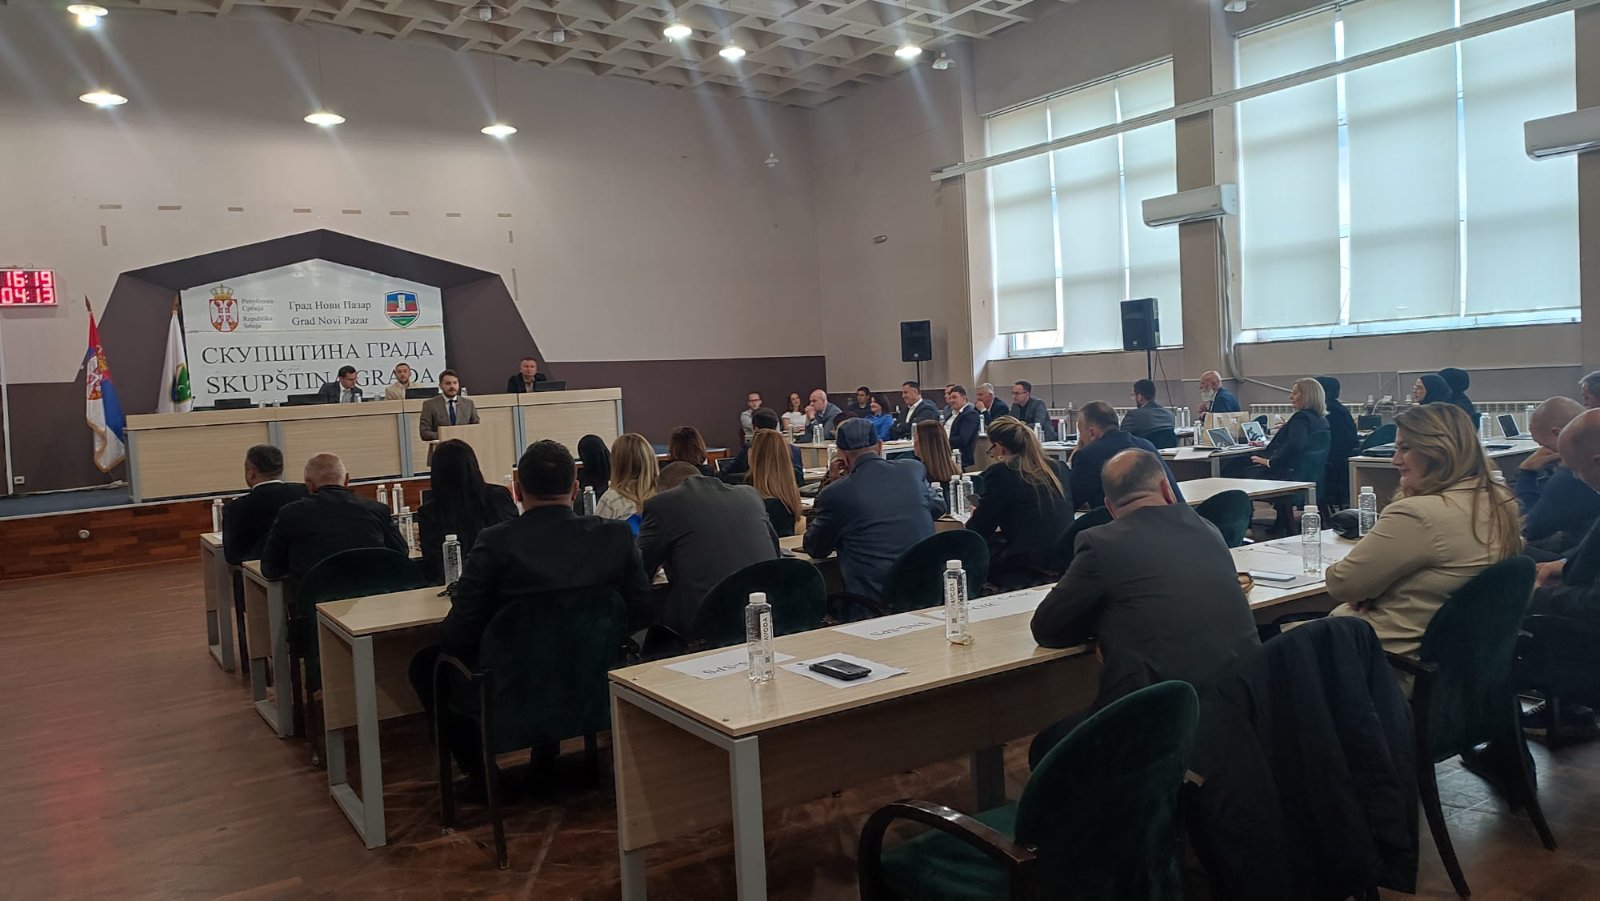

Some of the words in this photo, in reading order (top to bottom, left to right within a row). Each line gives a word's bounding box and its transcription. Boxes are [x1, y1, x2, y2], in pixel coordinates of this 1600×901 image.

[6, 271, 53, 287] 16:19
[1, 287, 54, 304] 04:13
[289, 301, 312, 312] Град
[315, 301, 341, 310] Нови
[343, 300, 372, 311] Пазар
[291, 316, 316, 326] Grad
[318, 315, 341, 325] Novi
[344, 315, 369, 325] Pazar
[201, 343, 360, 364] СКУПШТИНА
[366, 340, 434, 359] ГРАДА
[206, 368, 340, 394] SKUPŠTIN
